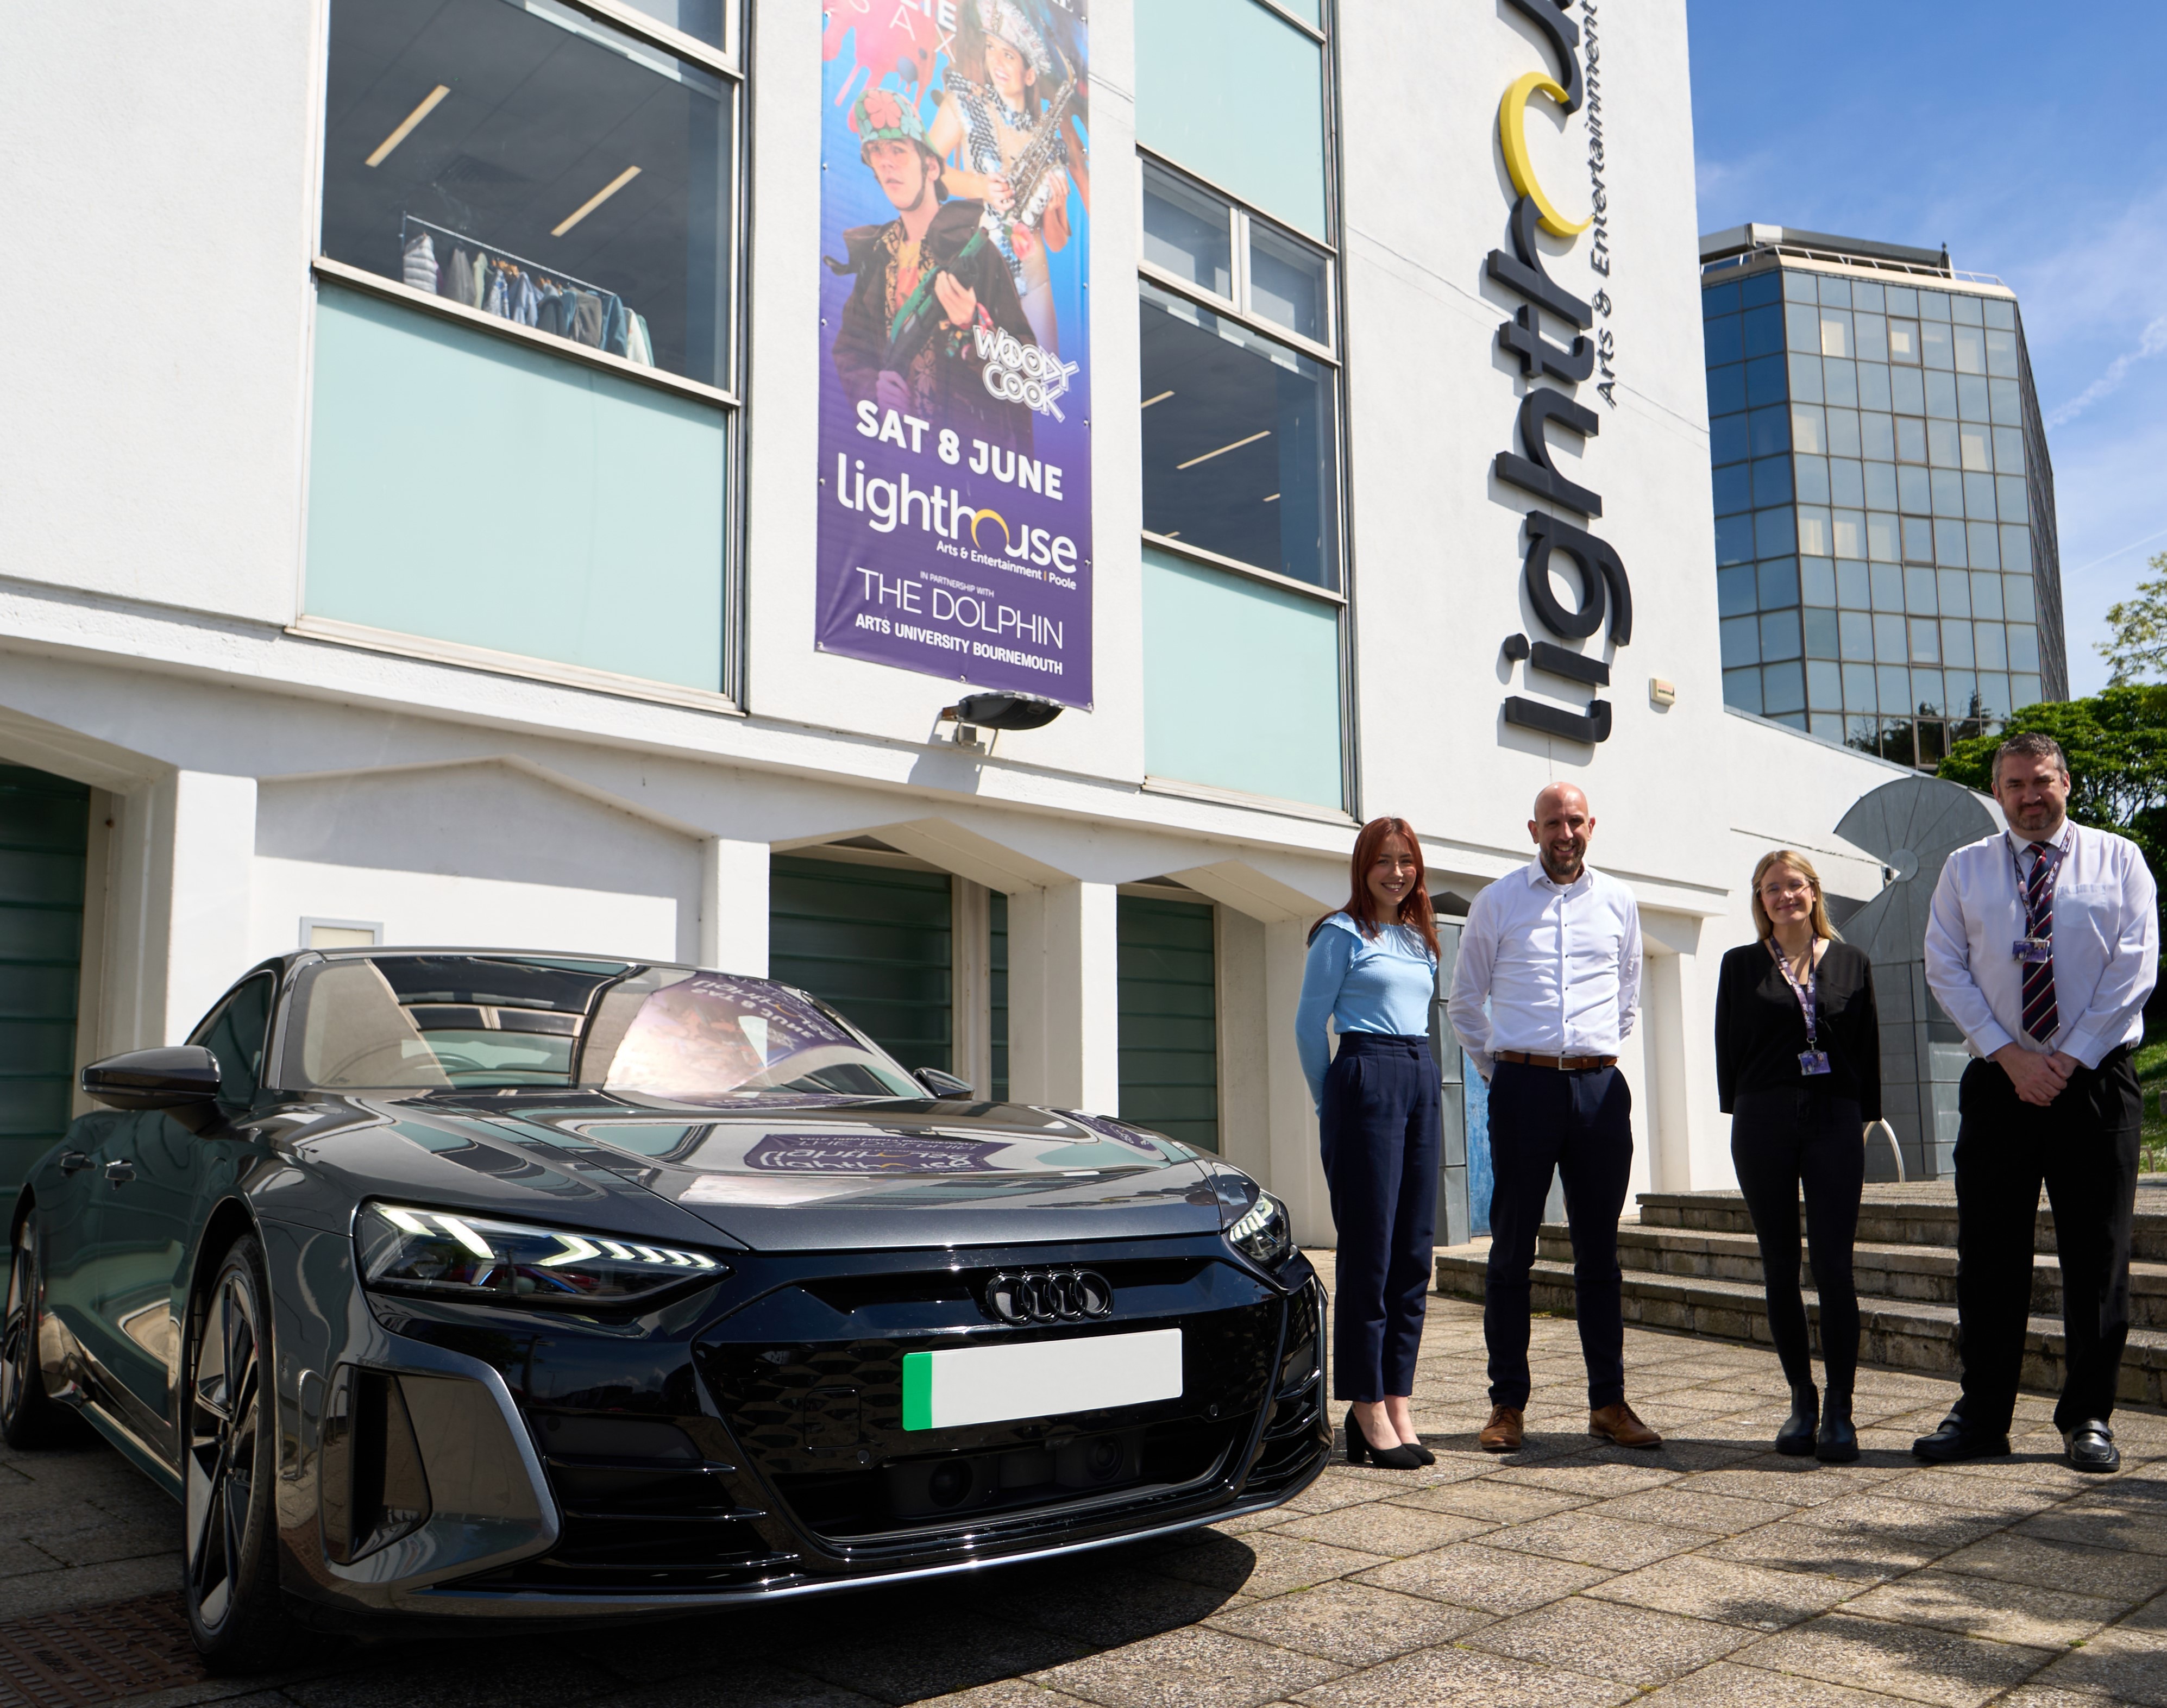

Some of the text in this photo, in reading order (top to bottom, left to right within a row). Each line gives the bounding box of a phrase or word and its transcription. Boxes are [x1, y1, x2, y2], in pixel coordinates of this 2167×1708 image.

[1577, 0, 1617, 409] Arts & Entertainment
[973, 325, 1080, 392] WOODY
[982, 361, 1065, 423] COOK
[856, 400, 1063, 501] SAT 8 JUNE
[837, 452, 1077, 574] lighthouse
[920, 570, 995, 598] IN PARTNERSHIP WITH
[937, 540, 958, 557] Arts
[960, 547, 969, 559] &
[971, 549, 1042, 580] Entertainment
[1049, 572, 1077, 591] Poole
[856, 566, 1063, 650] THE DOLPHIN
[855, 613, 1063, 675] ARTS UNIVERSITY BOURNEMOUTH
